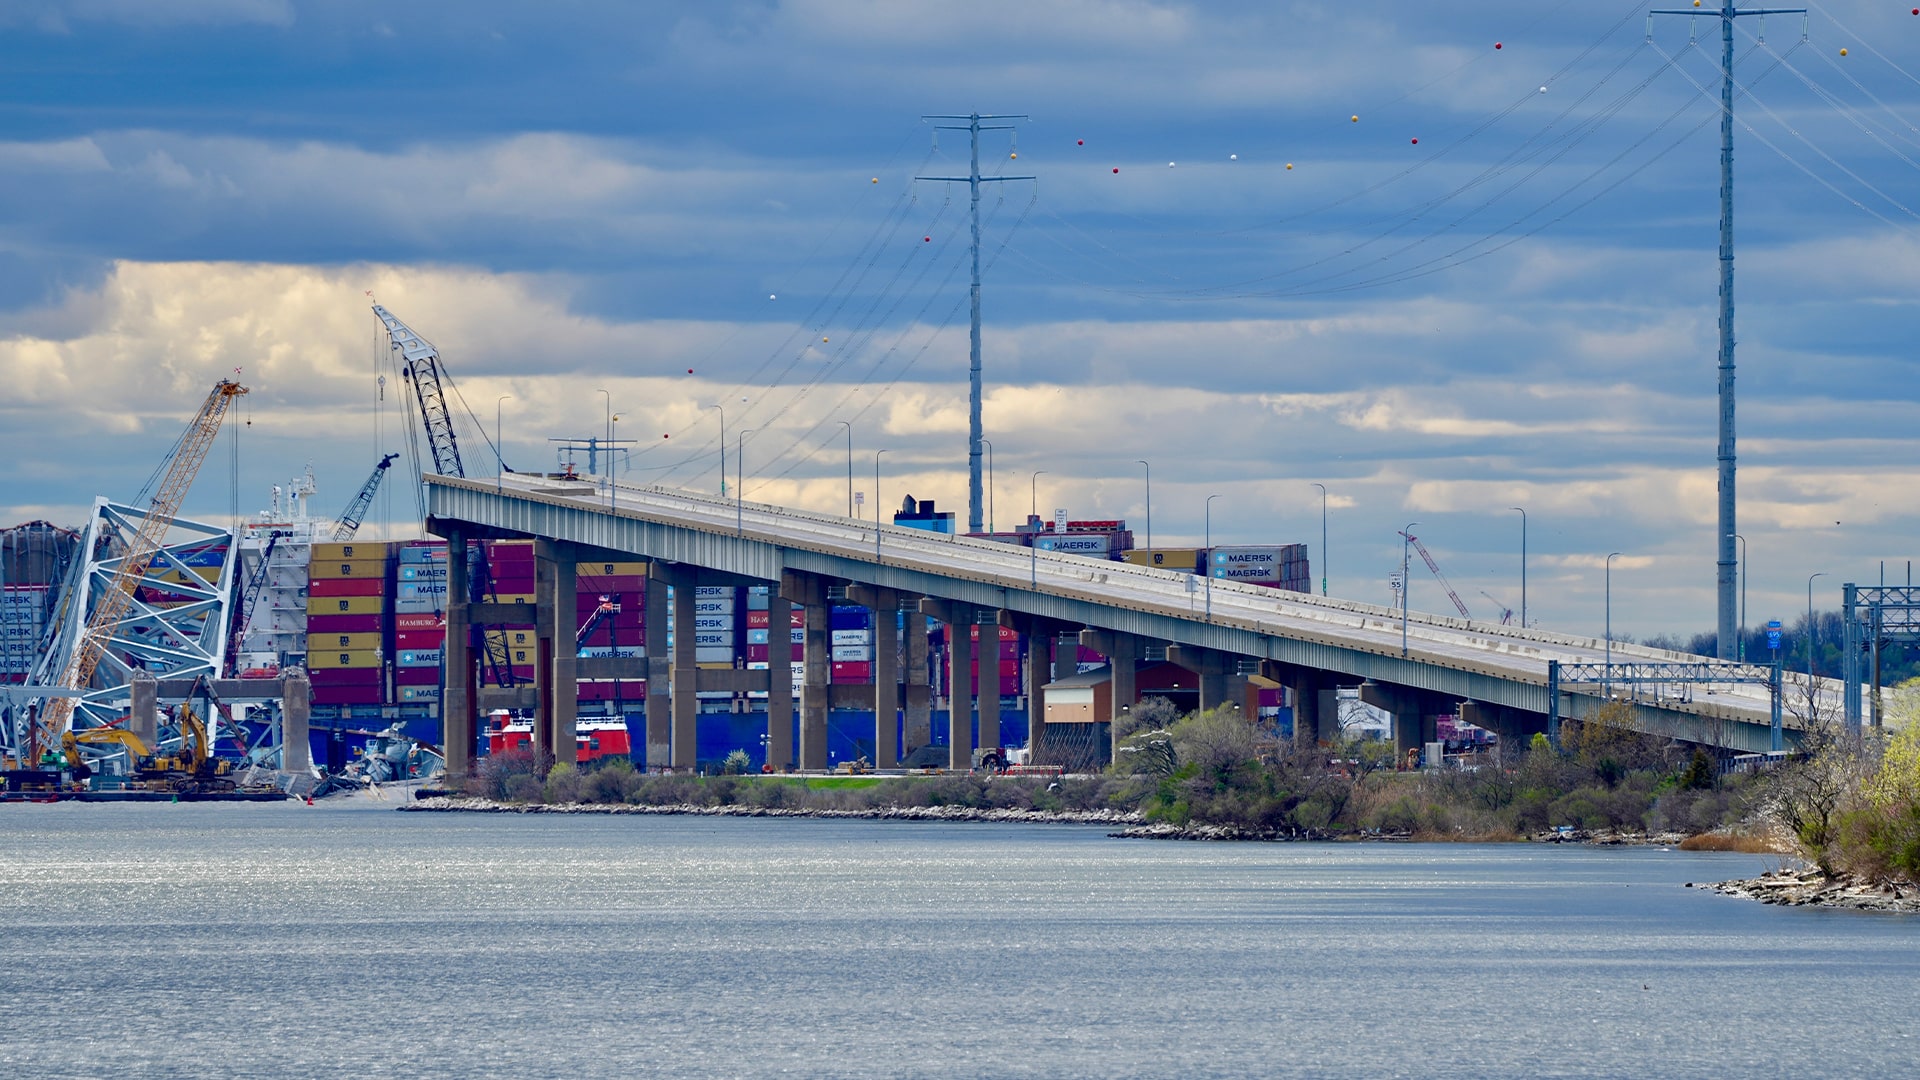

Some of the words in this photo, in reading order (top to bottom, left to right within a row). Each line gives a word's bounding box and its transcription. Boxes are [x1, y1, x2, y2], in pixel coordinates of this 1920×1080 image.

[1054, 541, 1098, 549] MAERSK
[1228, 554, 1273, 562] MAERSK
[1227, 568, 1271, 577] MAERSK
[399, 619, 434, 627] HAMBURG
